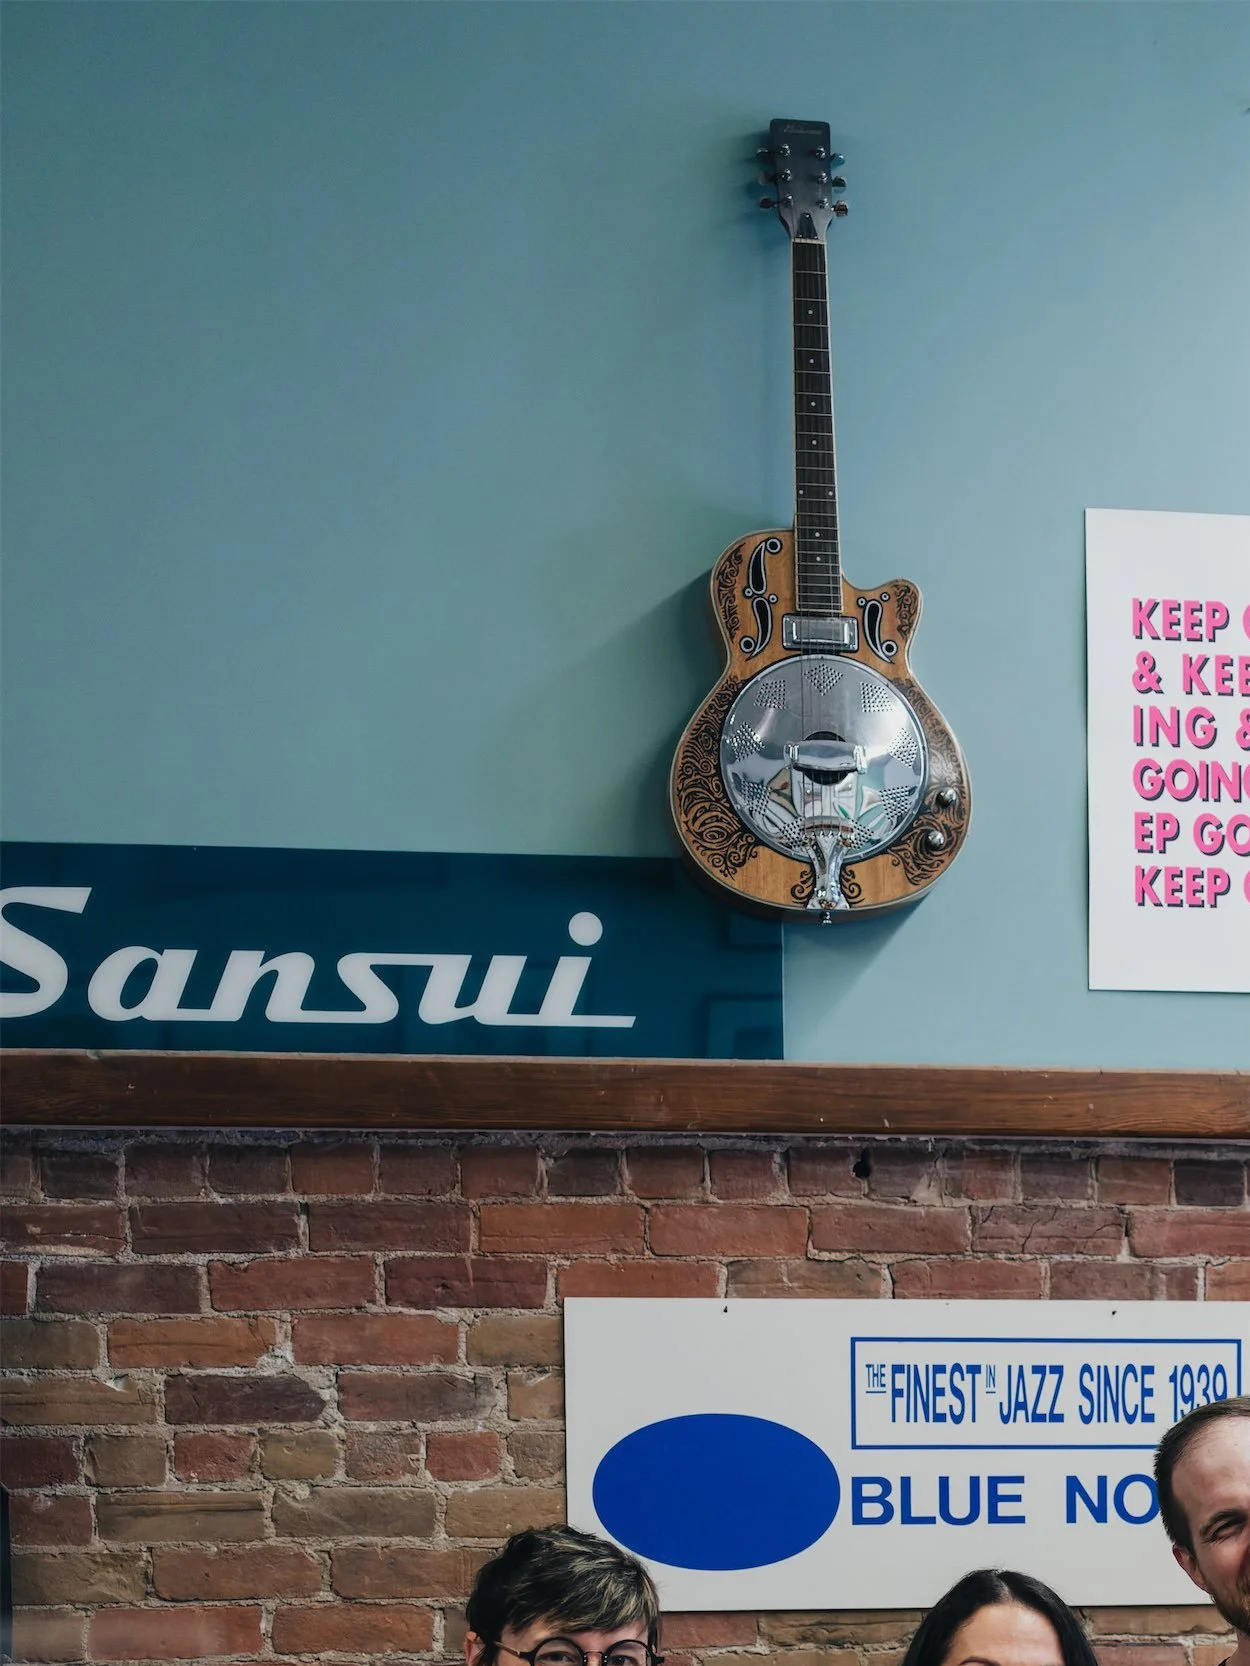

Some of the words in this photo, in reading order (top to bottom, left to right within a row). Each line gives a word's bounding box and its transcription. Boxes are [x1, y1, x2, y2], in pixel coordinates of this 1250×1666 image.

[1132, 598, 1230, 642] KEEP
[1132, 651, 1163, 694] &
[1132, 705, 1217, 750] ING
[1134, 812, 1180, 854] EP
[1134, 865, 1230, 910] KEEP
[0, 886, 637, 1028] Sansui
[866, 1364, 886, 1387] THE
[891, 1363, 981, 1424] FINEST
[986, 1364, 996, 1388] IN
[1000, 1364, 1064, 1424] JAZZ
[1079, 1363, 1155, 1424] SINCE
[1168, 1364, 1228, 1423] 1939
[852, 1476, 1026, 1525] BLUE
